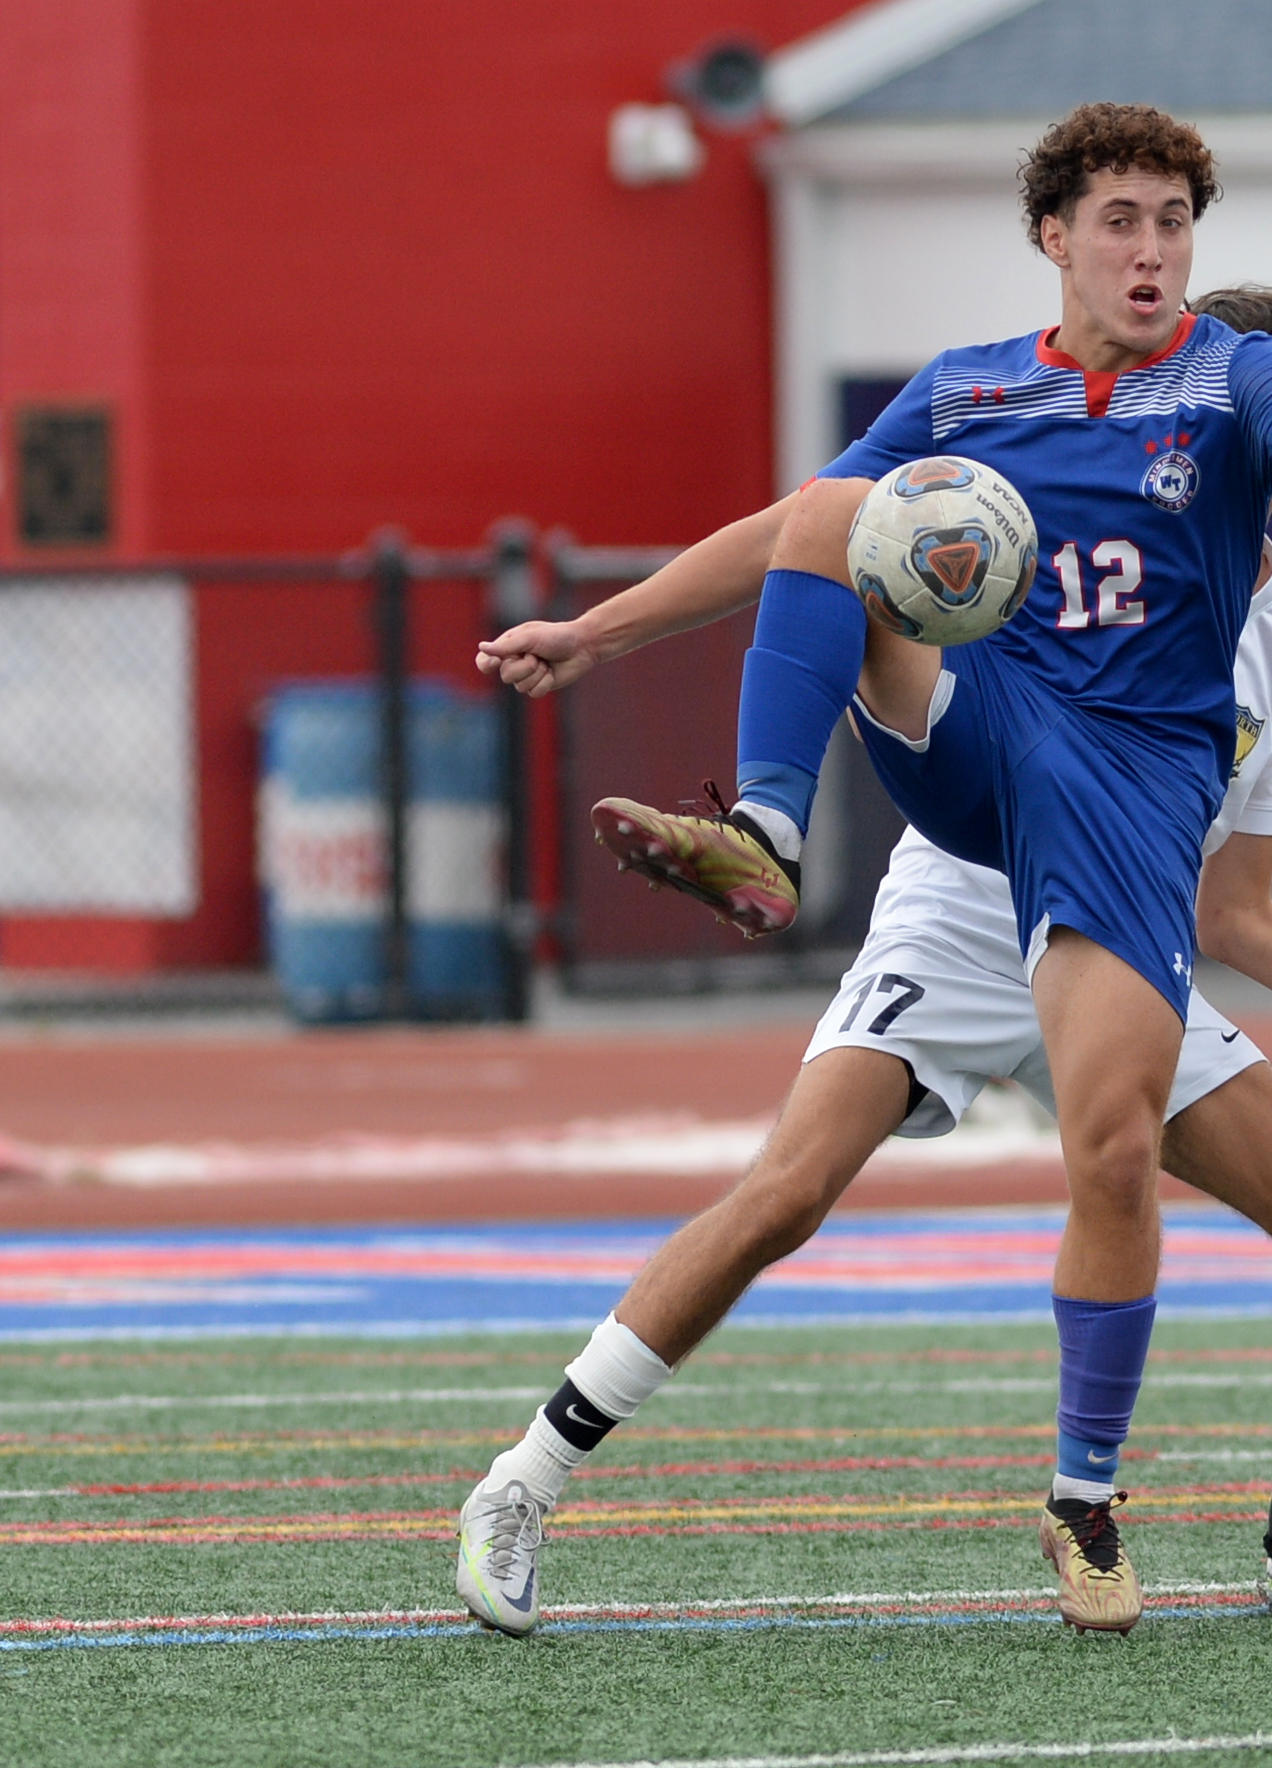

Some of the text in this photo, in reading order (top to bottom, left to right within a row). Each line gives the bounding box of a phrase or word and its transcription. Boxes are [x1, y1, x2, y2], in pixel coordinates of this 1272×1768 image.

[992, 481, 1029, 525] NCAA
[1160, 474, 1181, 492] WT
[976, 493, 1020, 549] Wilson
[1051, 538, 1146, 629] 12
[838, 973, 926, 1036] 17
